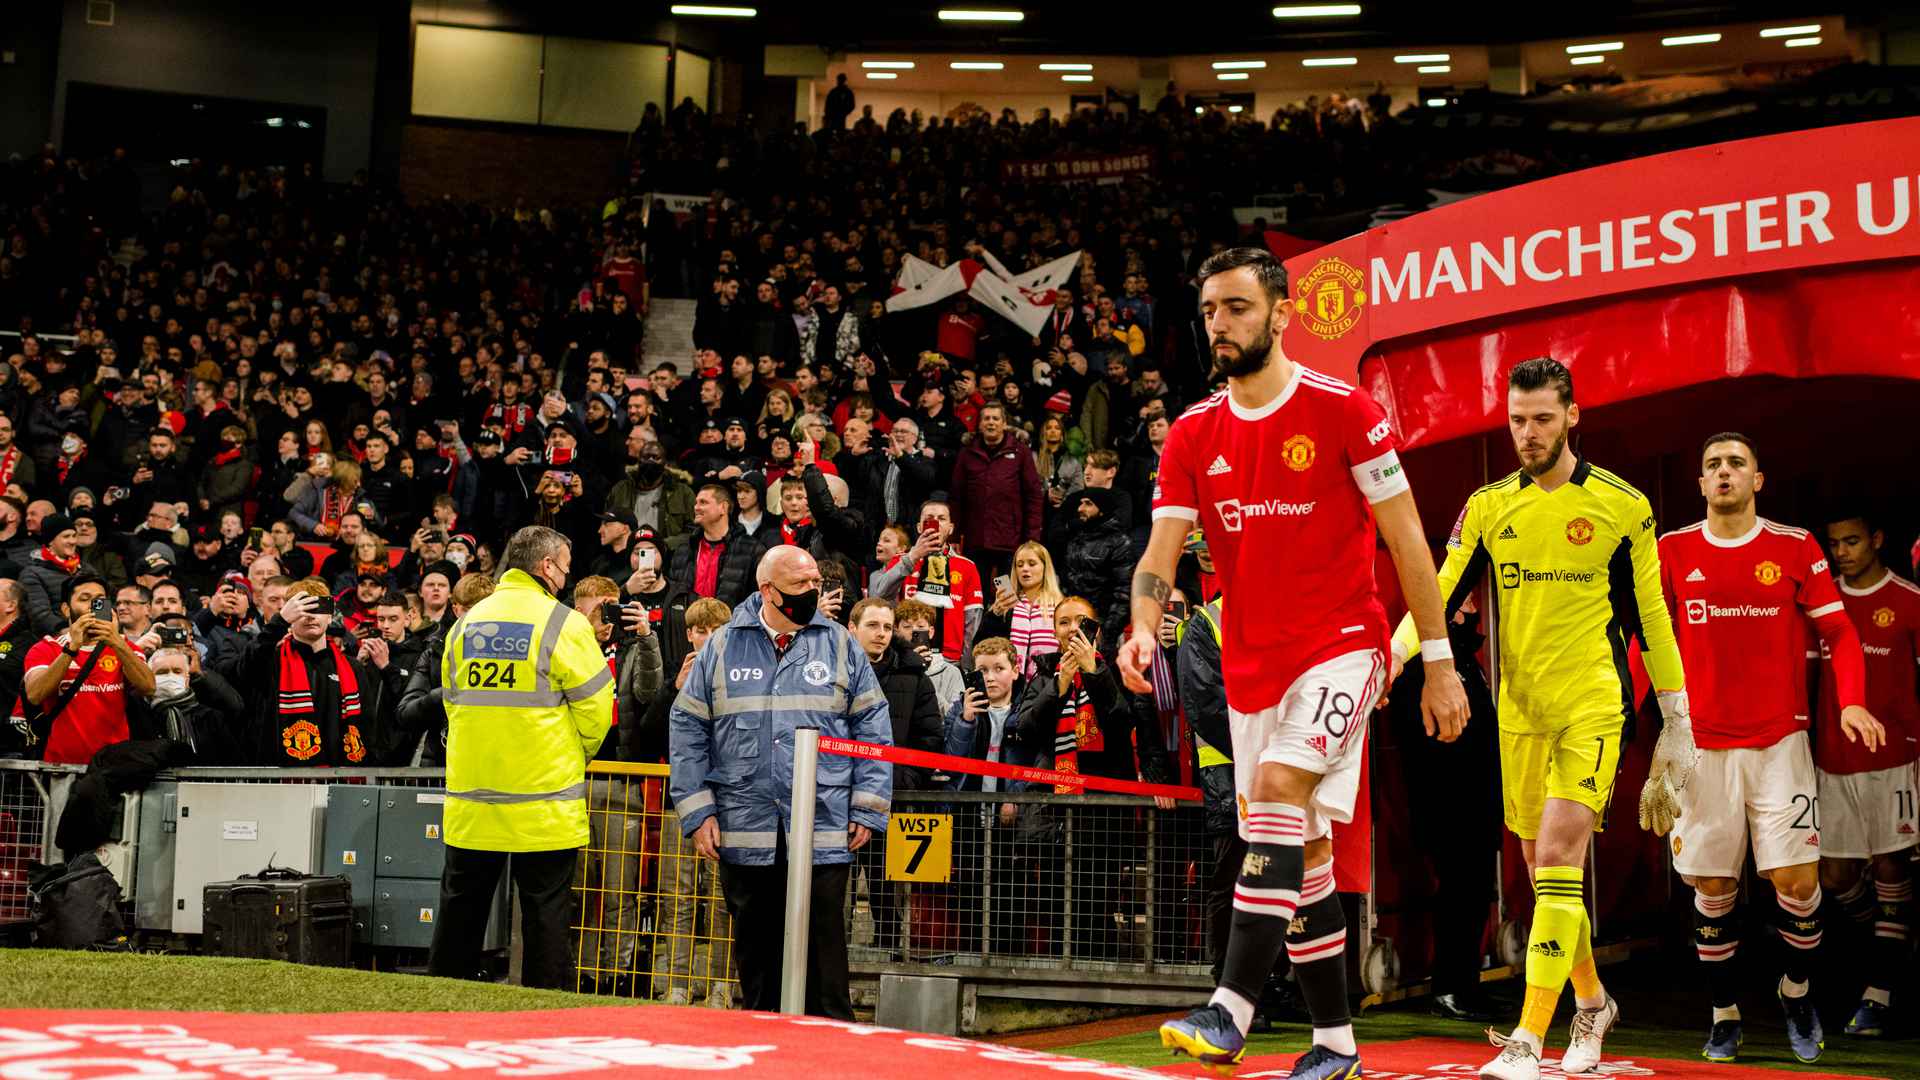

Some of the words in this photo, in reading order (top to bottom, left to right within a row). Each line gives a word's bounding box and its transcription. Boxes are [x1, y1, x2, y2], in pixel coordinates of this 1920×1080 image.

[1370, 189, 1835, 306] MANCHESTER
[1856, 175, 1920, 236] U
[1302, 262, 1361, 294] MANCHESTER
[1312, 318, 1352, 335] UNITED
[1521, 568, 1596, 583] TeamViewer
[1707, 604, 1781, 618] TeamViewer
[491, 636, 529, 654] CSG
[468, 661, 516, 689] 624
[729, 667, 763, 682] 079
[1311, 686, 1355, 738] 18
[832, 742, 854, 753] LEAVING
[859, 745, 871, 755] RED
[1594, 736, 1605, 773] 1
[1896, 790, 1914, 819] 11
[898, 818, 940, 833] WSP
[905, 835, 932, 875] 7
